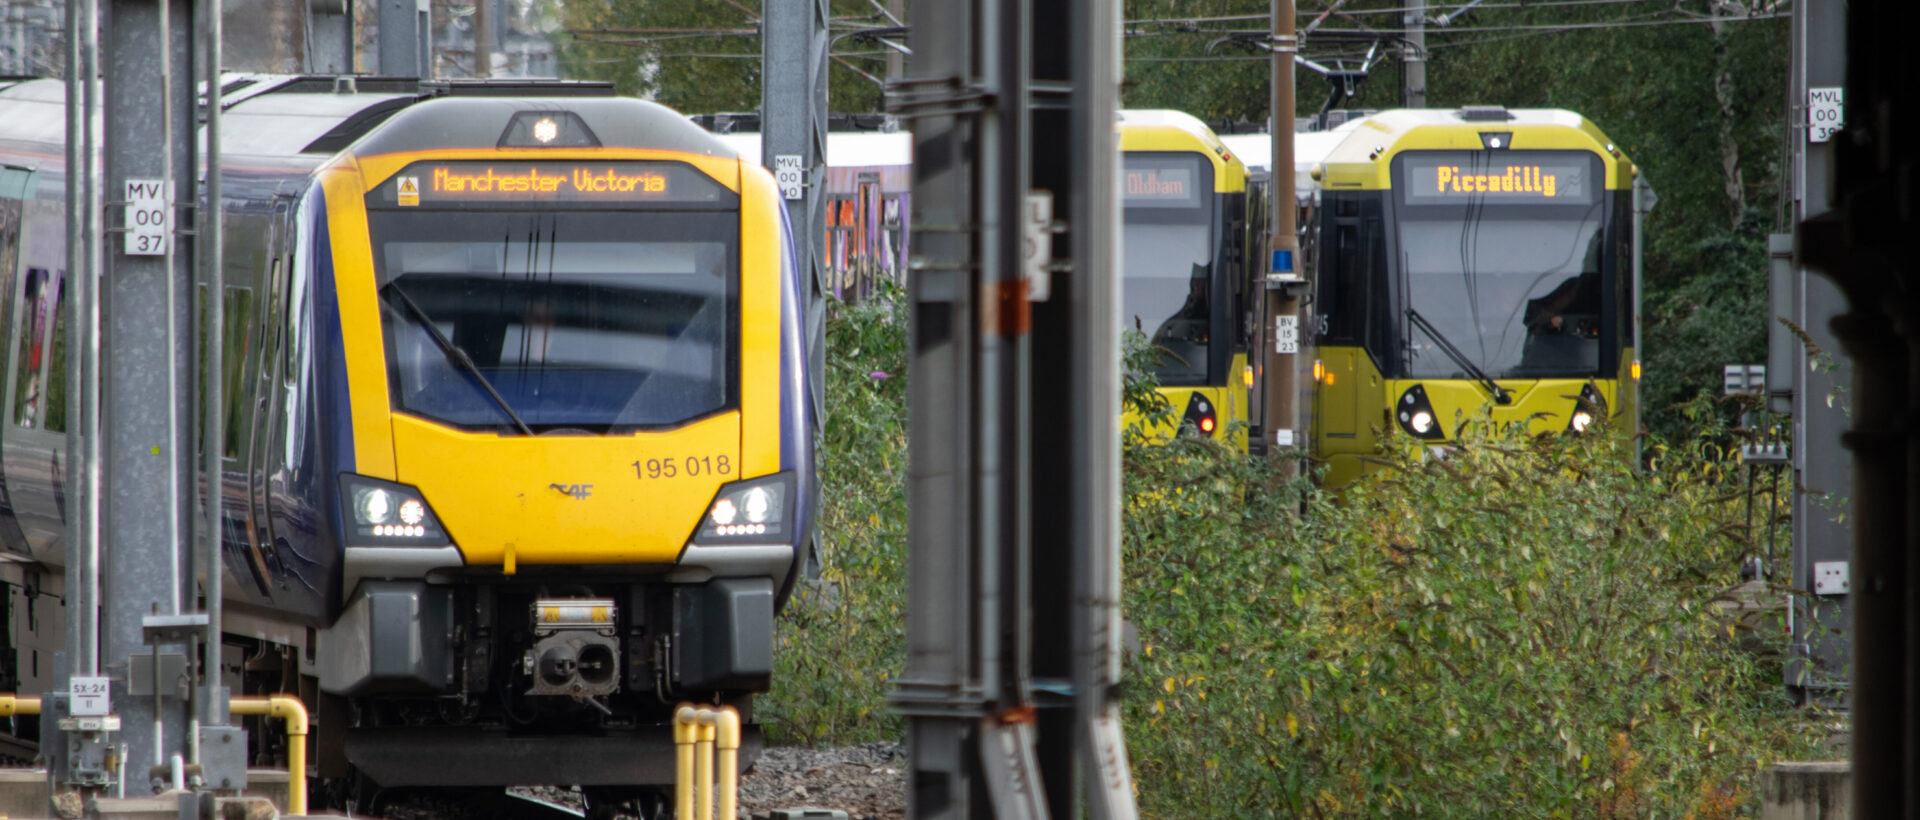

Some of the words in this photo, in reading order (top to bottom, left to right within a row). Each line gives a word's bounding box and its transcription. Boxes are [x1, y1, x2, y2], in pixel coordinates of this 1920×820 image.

[1811, 91, 1841, 103] MVL
[1816, 109, 1837, 121] 00
[777, 158, 801, 168] MVL
[434, 169, 567, 191] Manchester
[573, 169, 666, 191] Victoria
[780, 172, 797, 183] 00
[1127, 173, 1184, 194] Oldham
[1437, 165, 1556, 197] Piccadilly
[136, 209, 164, 226] 00
[137, 235, 163, 251] 37
[631, 458, 678, 480] 195
[685, 455, 732, 476] 018
[73, 684, 106, 693] SX-24
